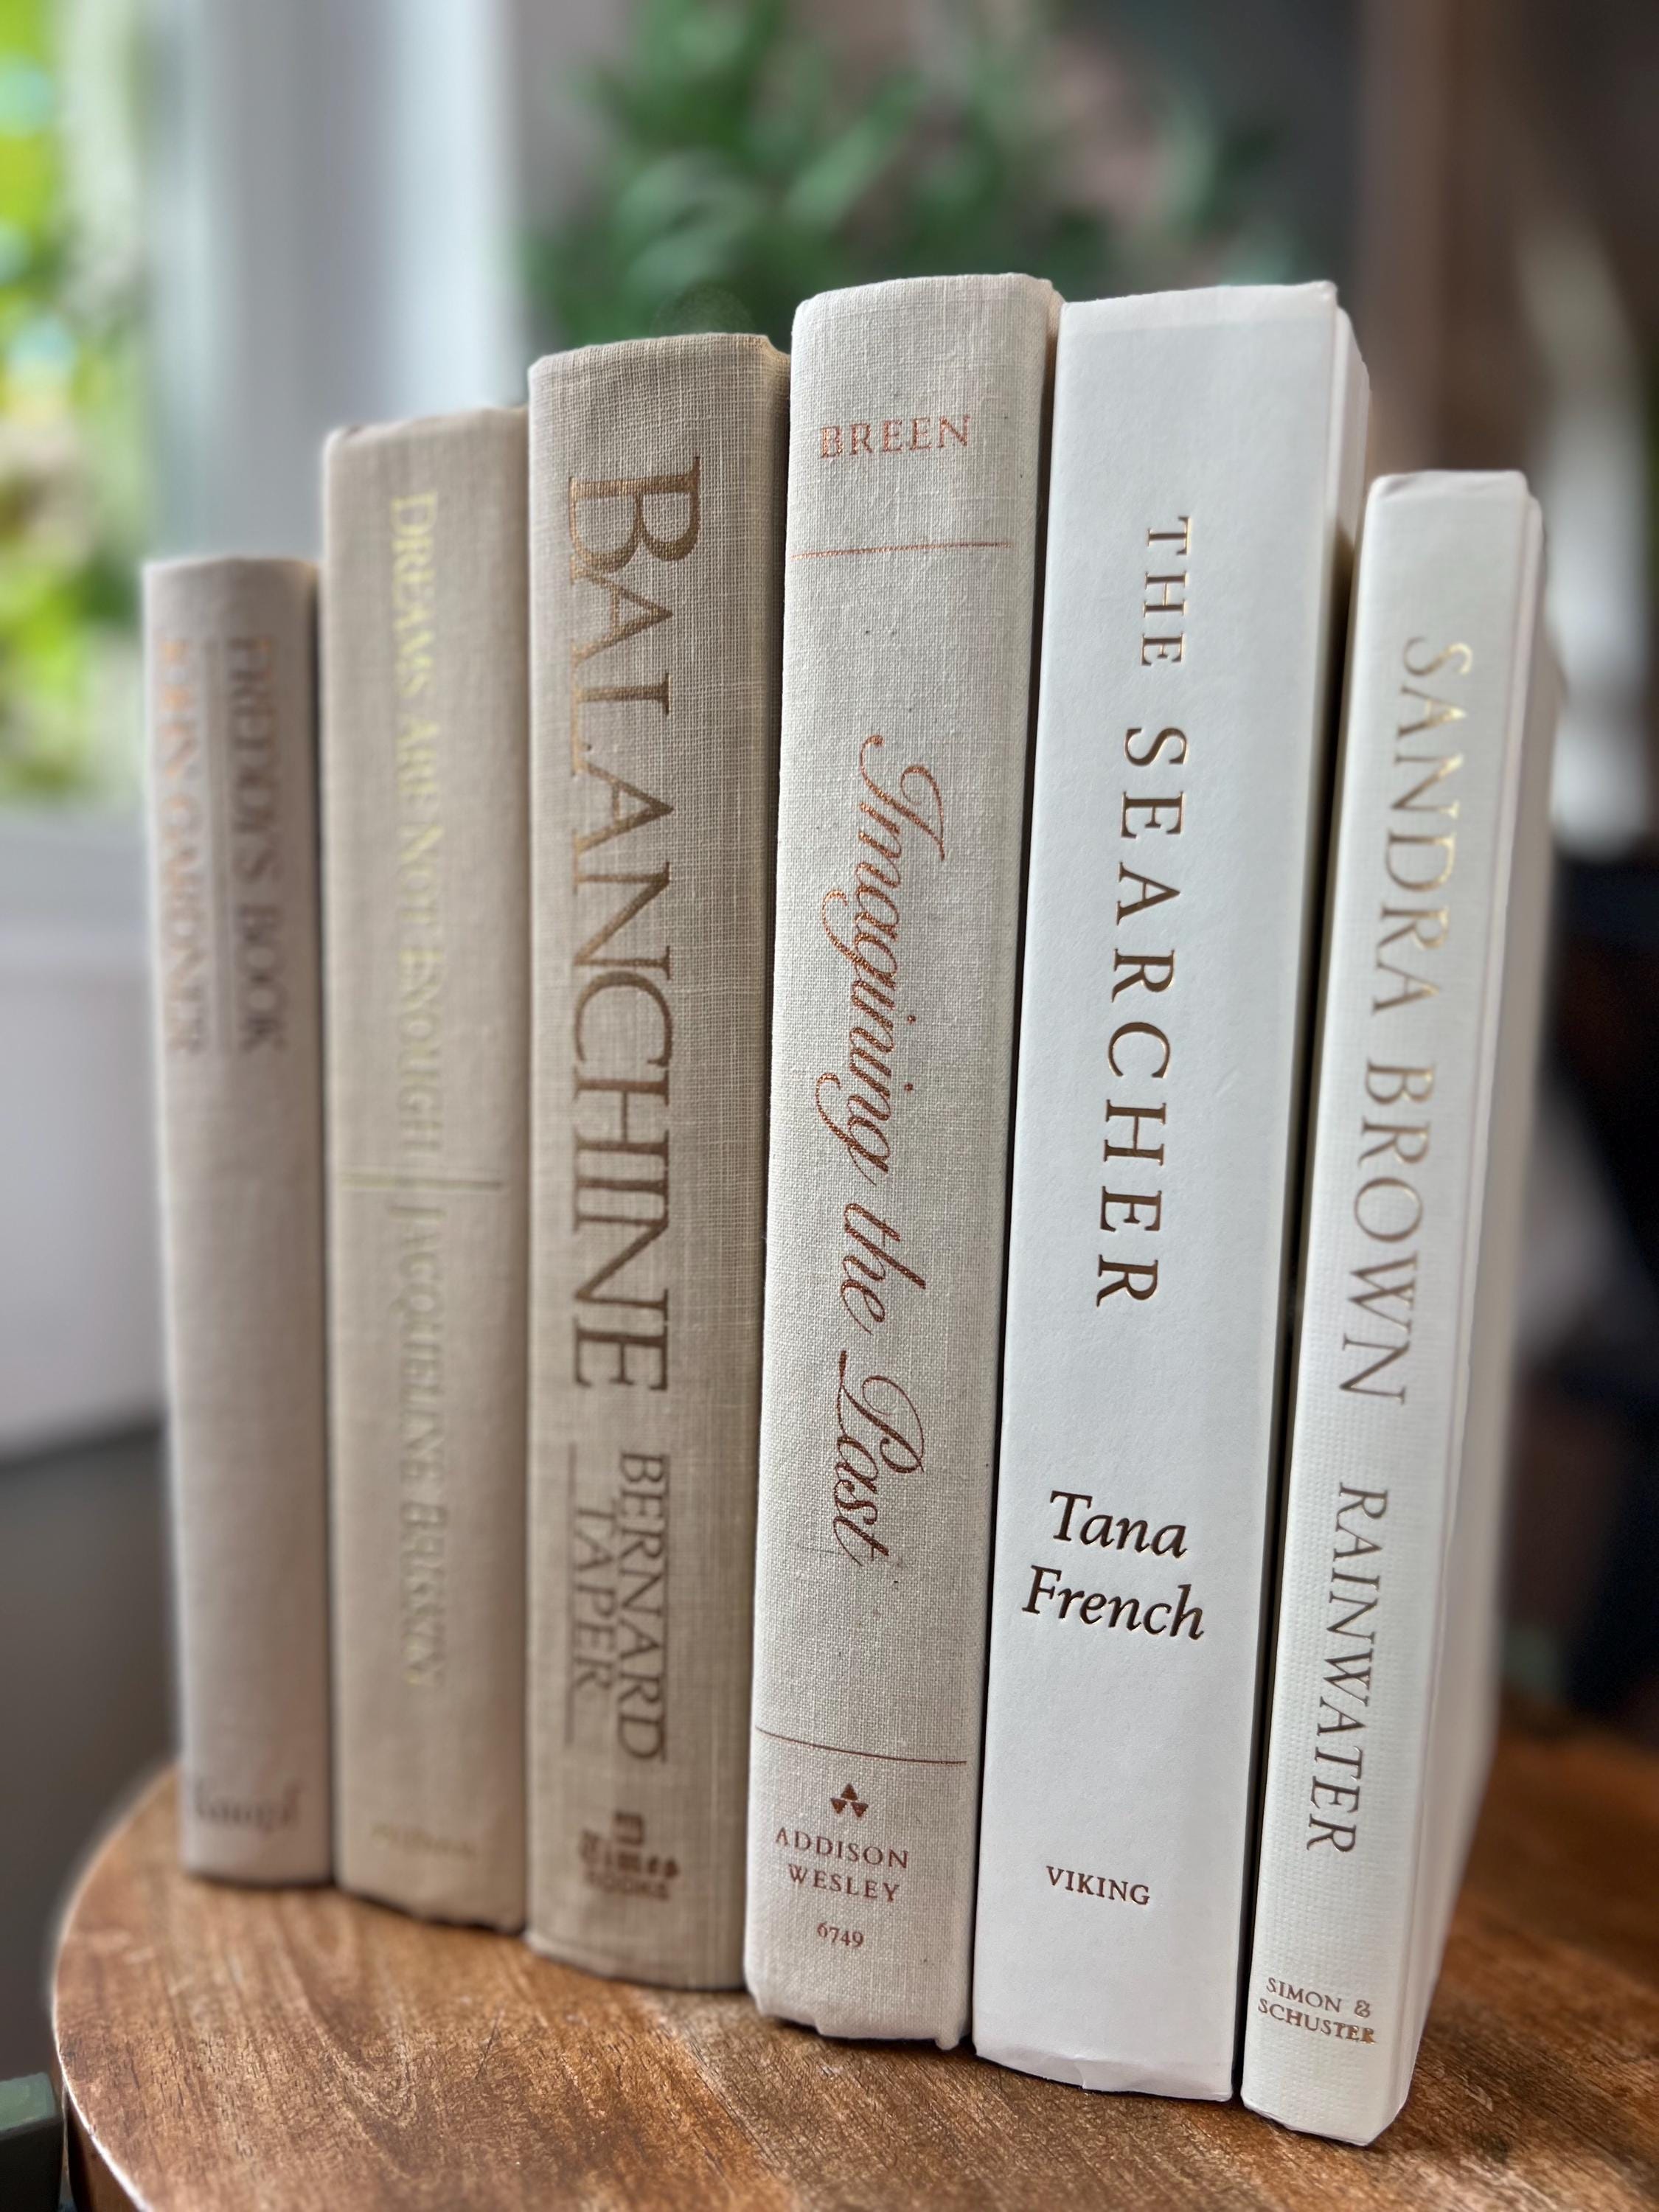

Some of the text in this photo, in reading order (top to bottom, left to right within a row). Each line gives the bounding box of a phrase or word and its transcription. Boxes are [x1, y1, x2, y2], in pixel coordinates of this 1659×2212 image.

[819, 414, 971, 459] BREEN
[567, 456, 701, 1394] BALANCHINE
[1096, 515, 1192, 1309] THE SEARCHER
[1339, 636, 1473, 1407] SANDRA BROWN
[815, 734, 946, 1568] Imagining the Past
[1049, 1489, 1189, 1559] Tana
[571, 1498, 618, 1693] TAPER
[616, 1451, 669, 1762] BERNARD
[1022, 1564, 1205, 1641] French
[1306, 1481, 1389, 1853] RAINWATER
[775, 1826, 909, 1869] ADDISON
[788, 1863, 900, 1903] WESLEY
[1046, 1865, 1151, 1905] VIKING
[816, 1921, 865, 1948] 6749
[1257, 1997, 1377, 2045] SCHUSTER
[1266, 1976, 1371, 2019] SIMON &
